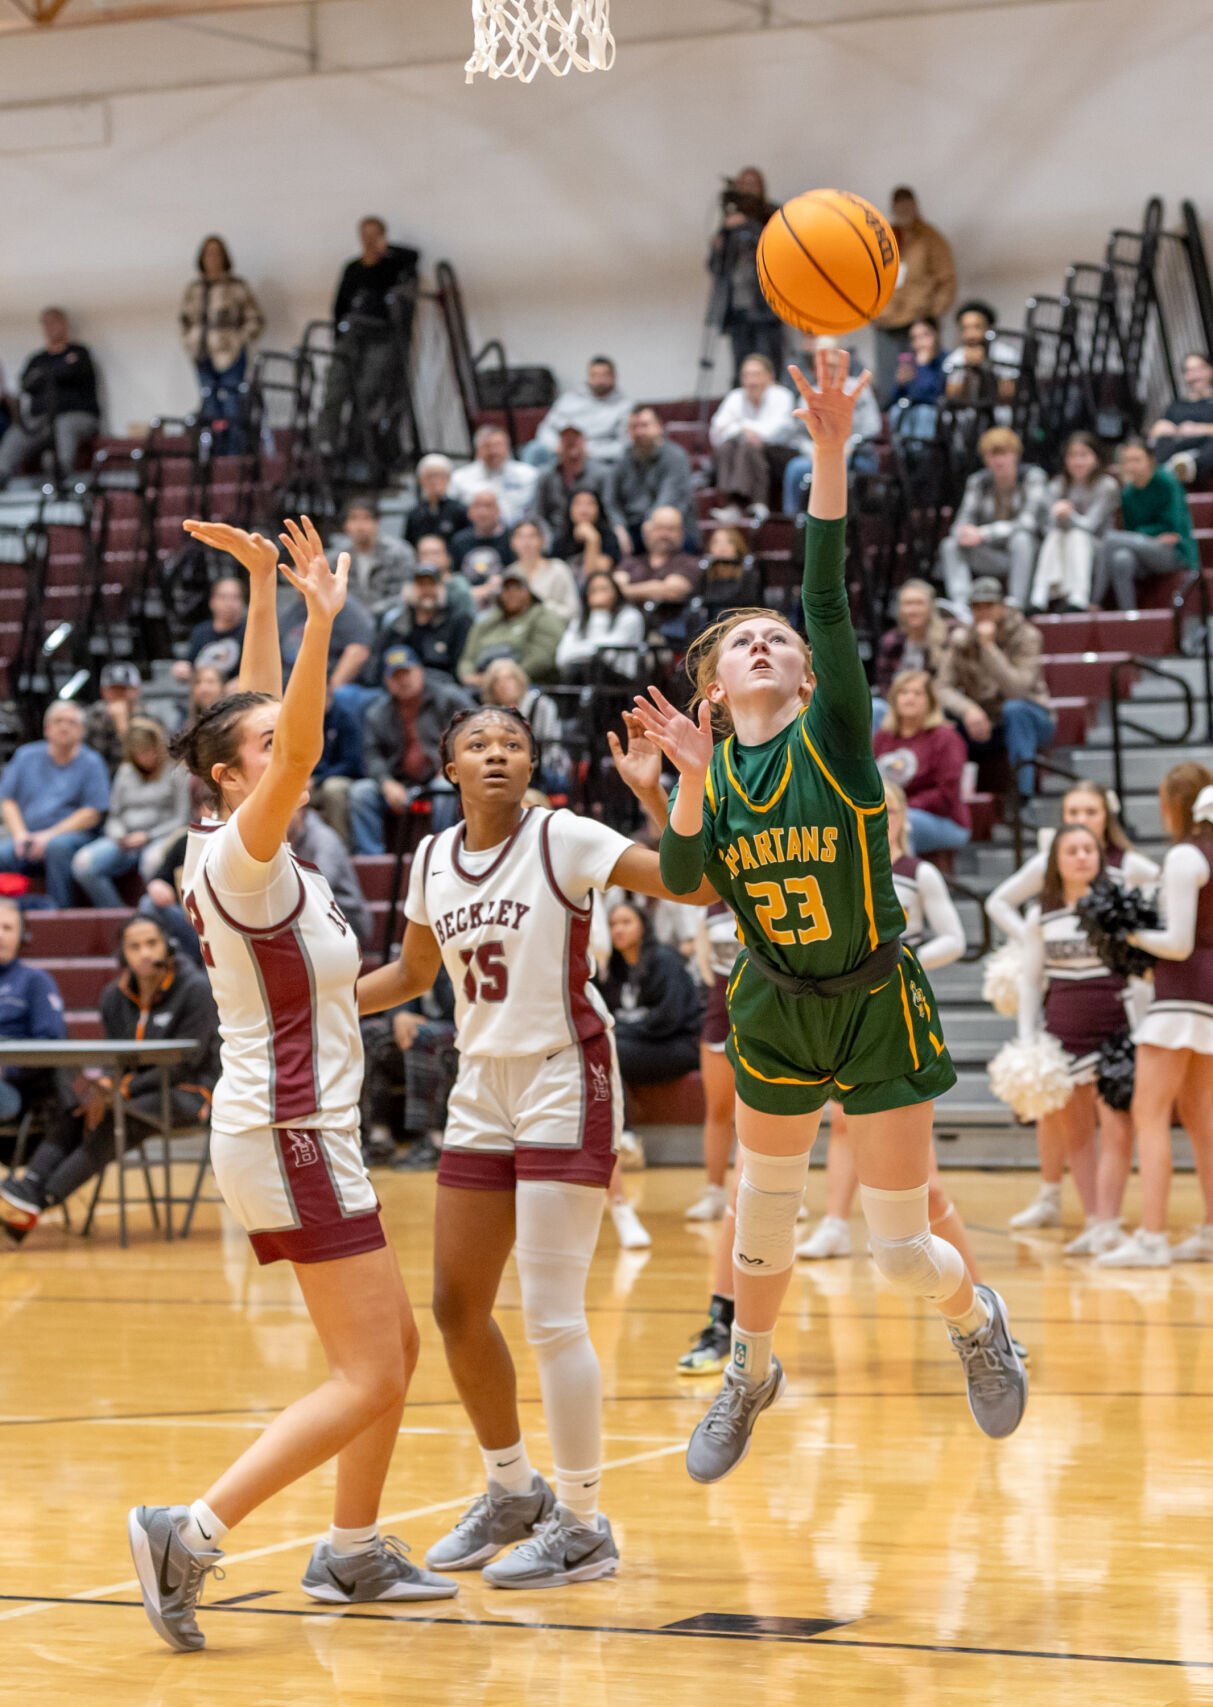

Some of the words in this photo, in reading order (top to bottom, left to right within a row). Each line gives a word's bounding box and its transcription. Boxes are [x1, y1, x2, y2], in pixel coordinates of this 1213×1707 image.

[719, 826, 838, 880] PARTANS
[435, 899, 530, 946] BECKLEY
[745, 874, 832, 945] 23
[459, 940, 508, 1004] 15
